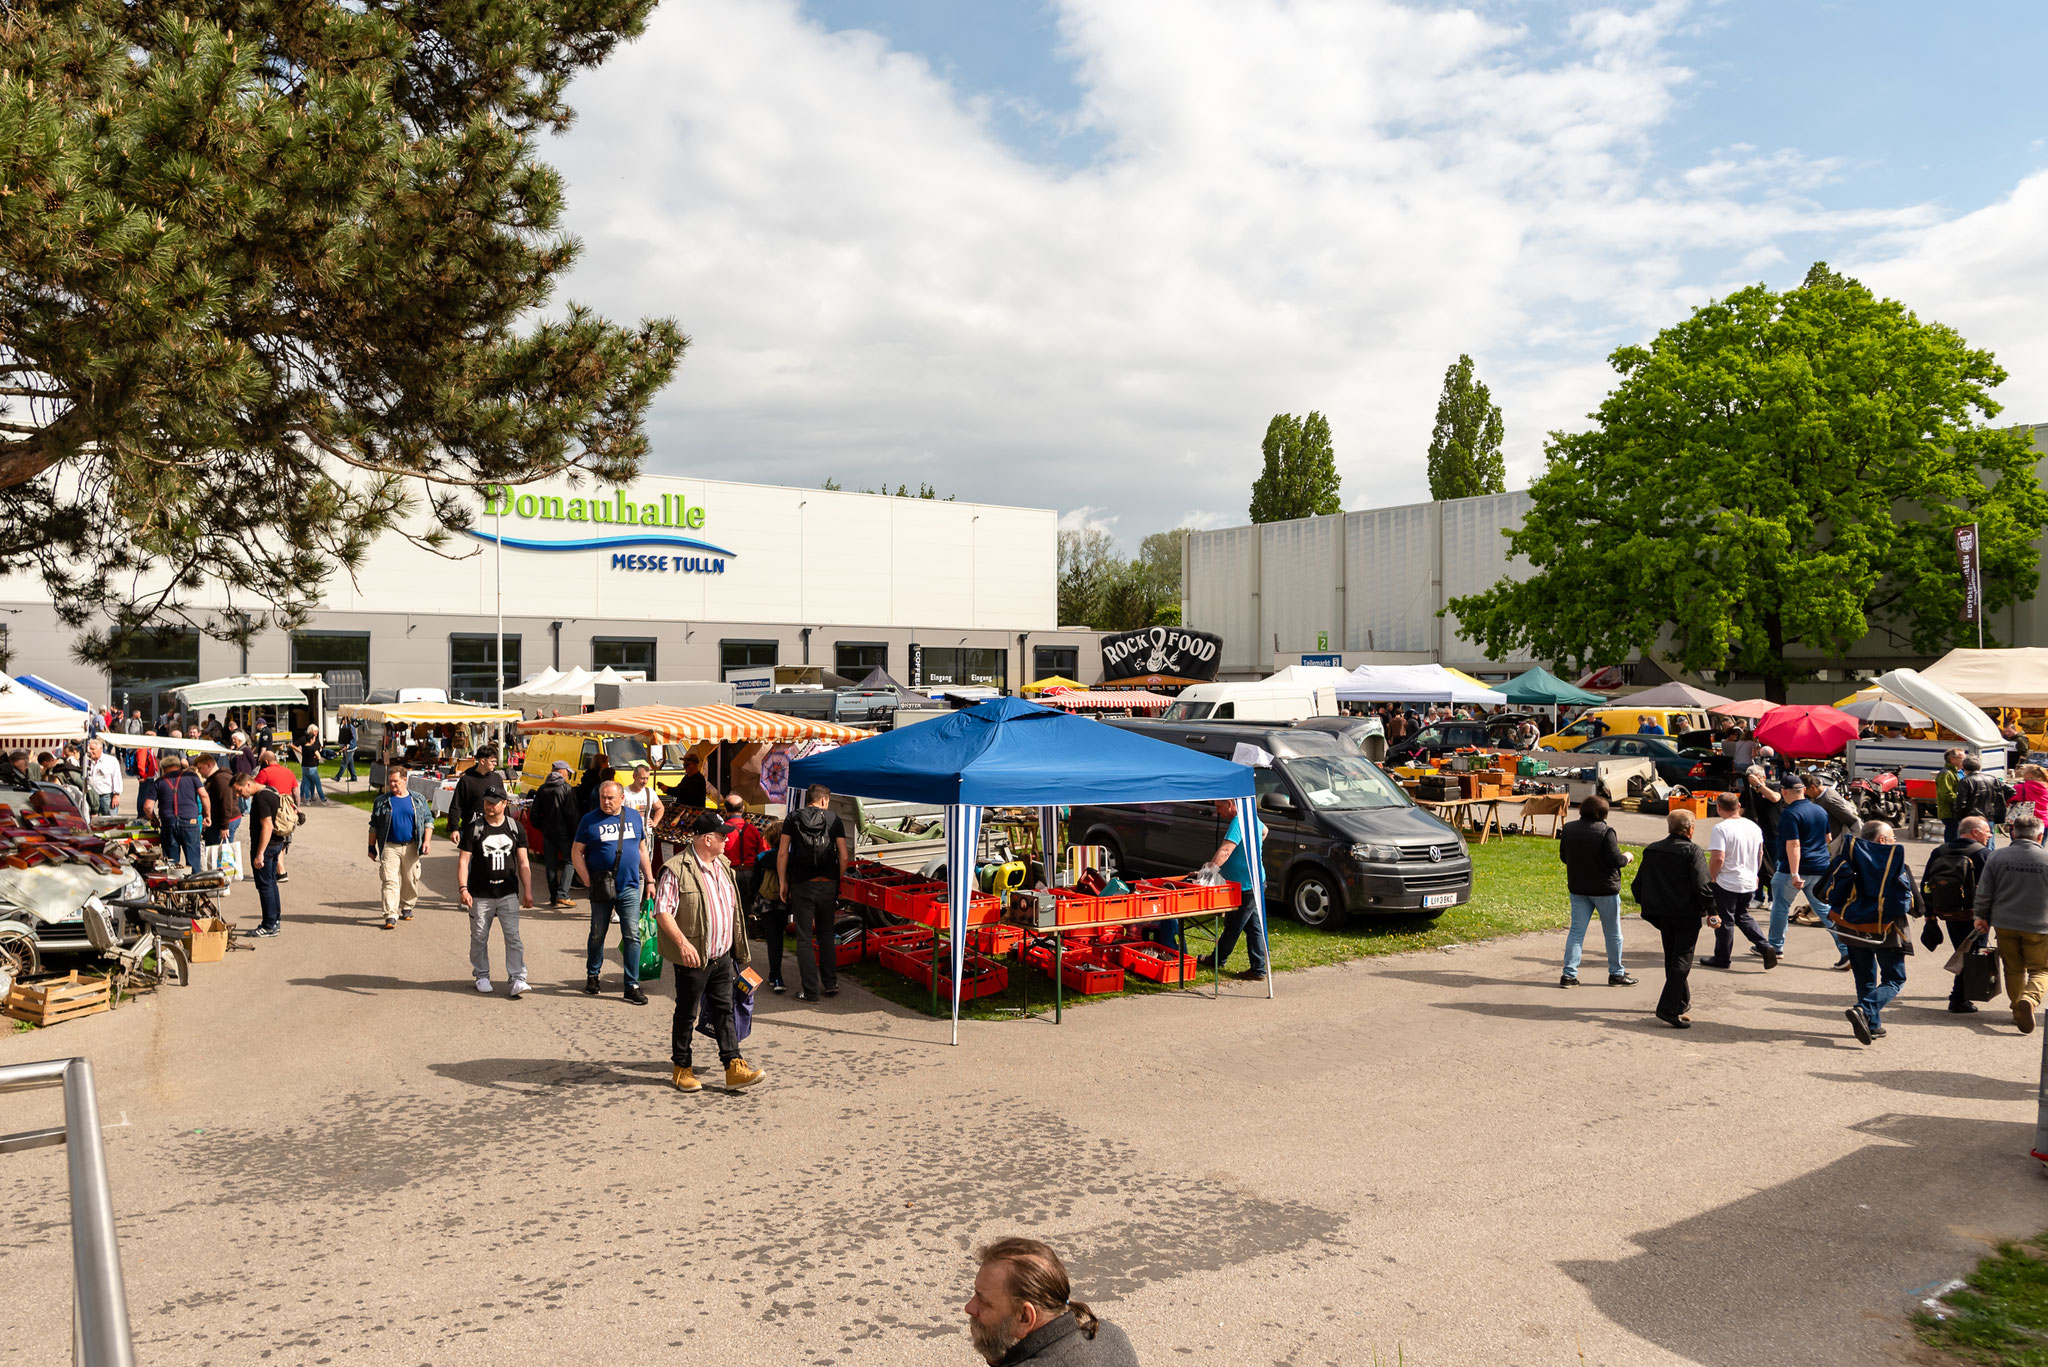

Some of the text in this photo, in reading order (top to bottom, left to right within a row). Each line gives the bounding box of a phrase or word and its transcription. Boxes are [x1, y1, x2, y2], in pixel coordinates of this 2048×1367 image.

[484, 484, 706, 529] Donauhalle
[612, 553, 725, 574] MESSE TULLN
[1103, 634, 1149, 666] ROCK
[1168, 632, 1216, 662] FOOD
[1320, 638, 1326, 650] 2
[930, 673, 953, 683] Eingang
[971, 673, 993, 683] Eingang
